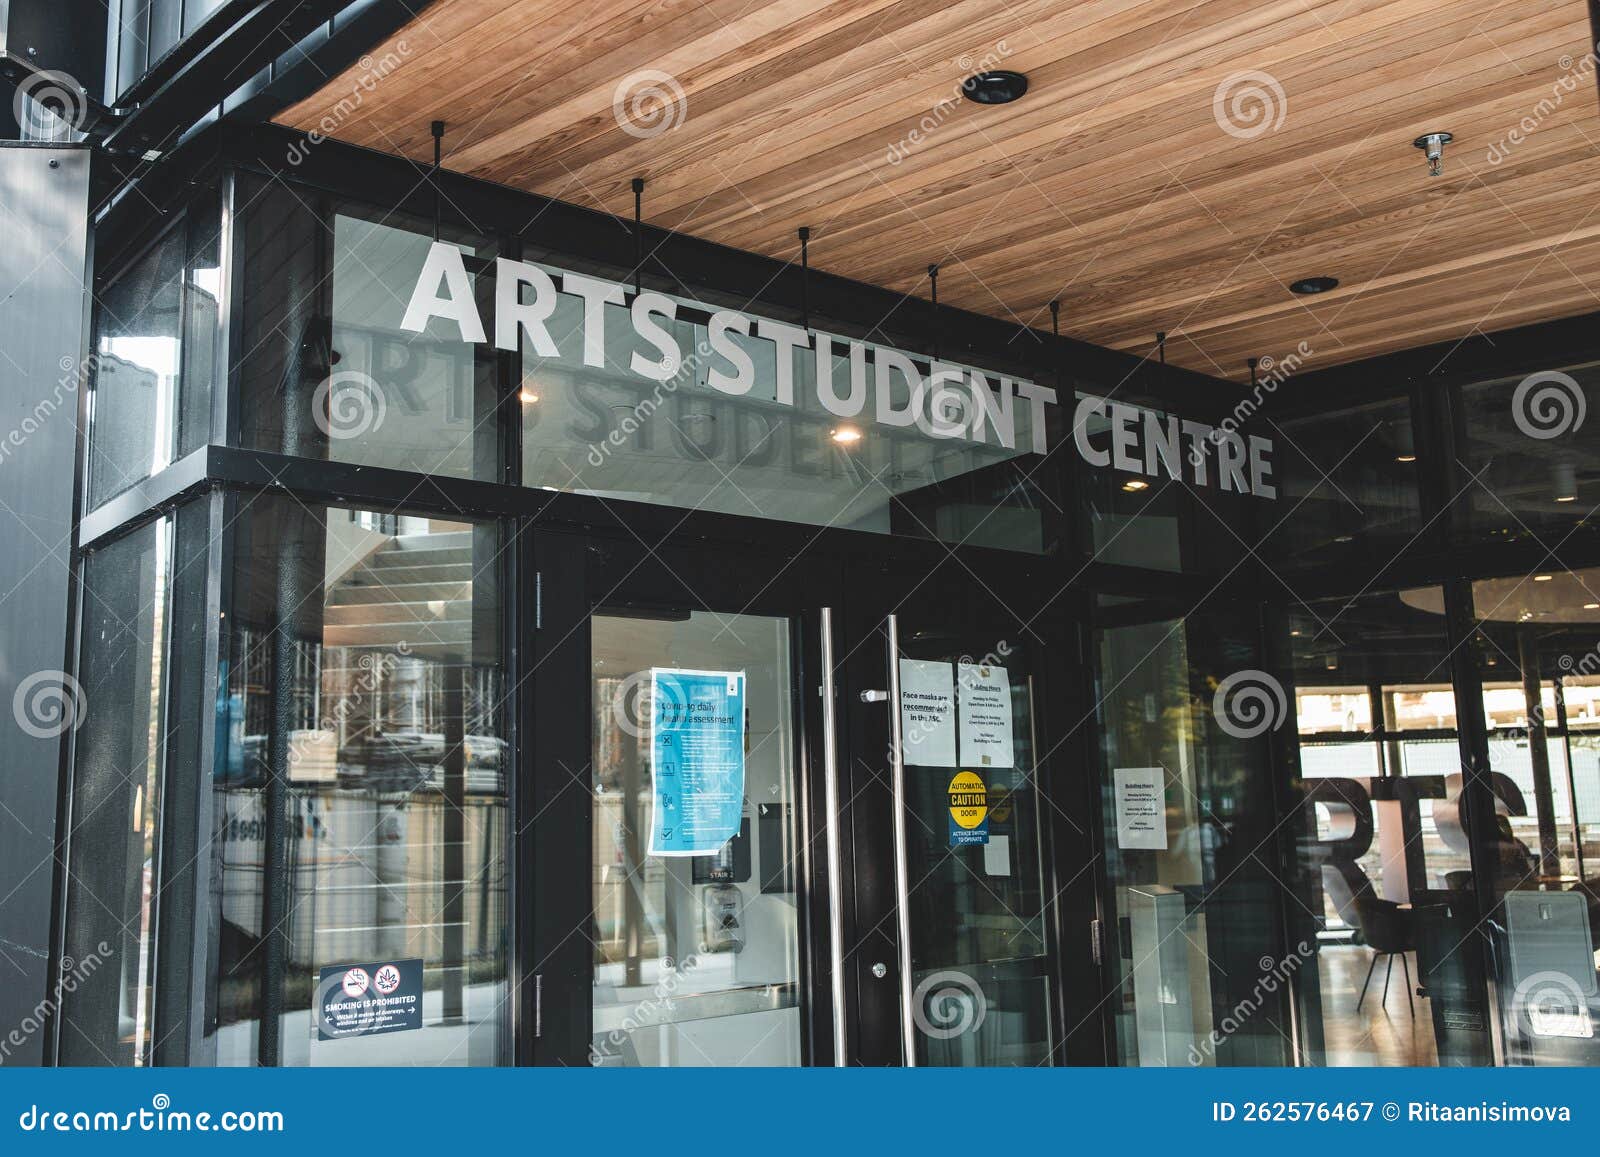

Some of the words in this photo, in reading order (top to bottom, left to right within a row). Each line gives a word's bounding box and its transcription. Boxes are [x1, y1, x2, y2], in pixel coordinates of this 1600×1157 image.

[400, 241, 681, 381] ARTS
[707, 310, 1058, 456] STUDENT
[1073, 396, 1277, 500] CENTRE
[903, 691, 918, 699] Face
[697, 702, 716, 712] daily
[689, 715, 734, 724] assessment
[951, 782, 984, 790] AUTOMATIC
[951, 794, 986, 806] CAUTION
[960, 809, 978, 817] DOOR
[710, 871, 728, 879] STAIR
[325, 1001, 362, 1012] SMOKING
[363, 1000, 371, 1008] IS
[372, 995, 416, 1007] PROHIBITED
